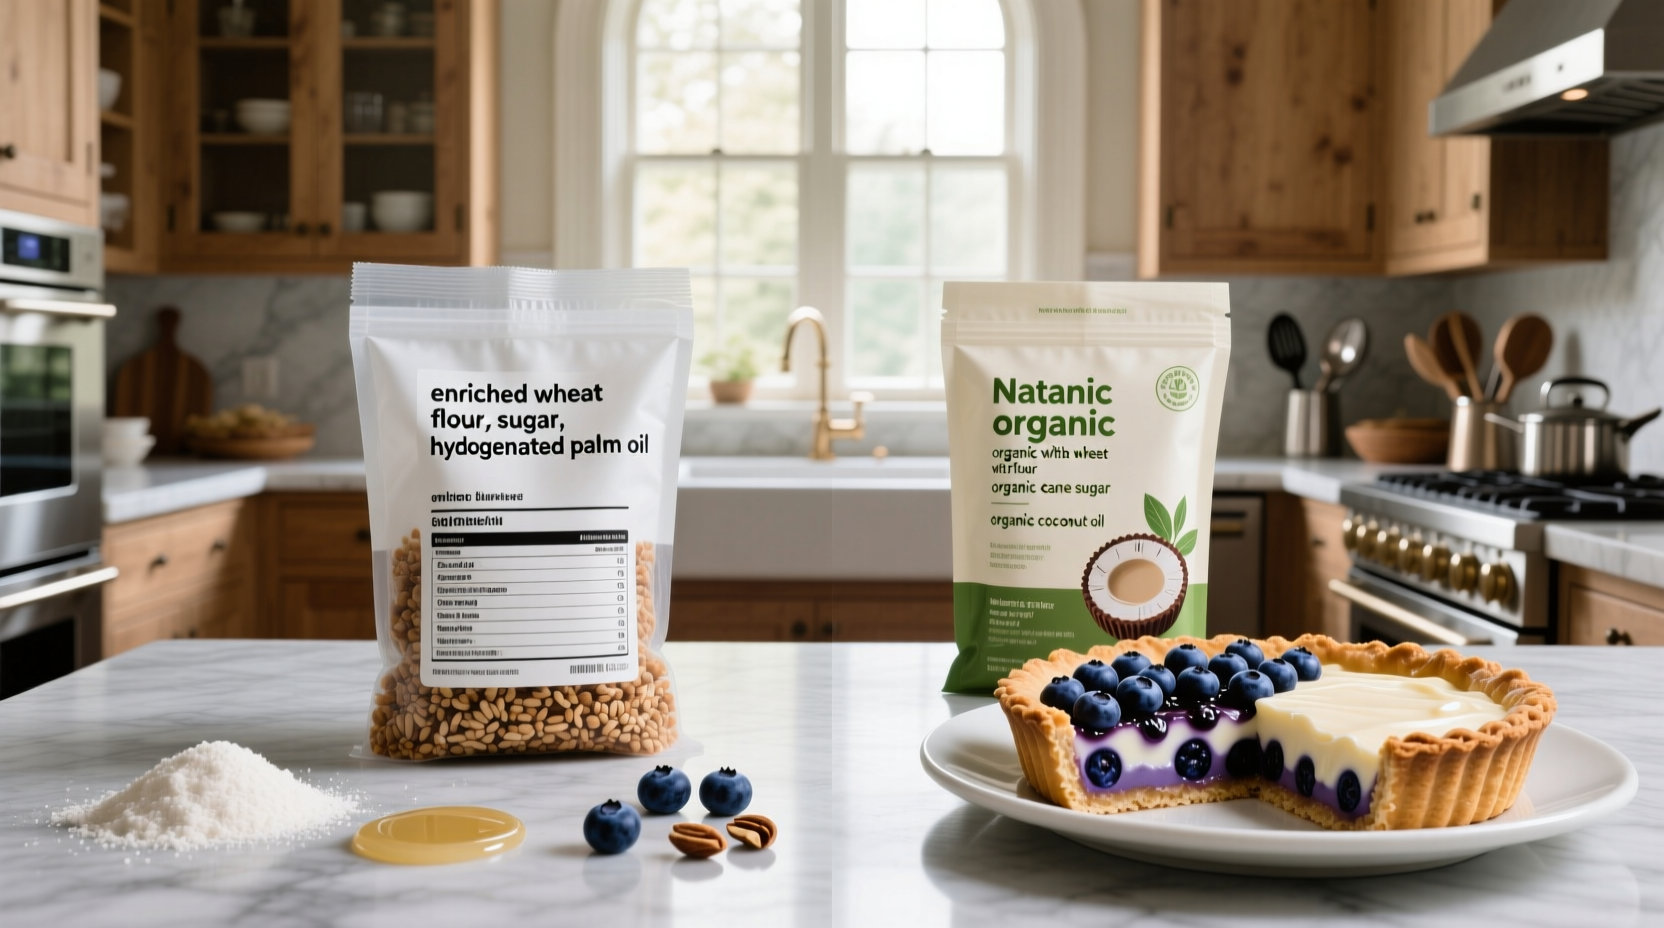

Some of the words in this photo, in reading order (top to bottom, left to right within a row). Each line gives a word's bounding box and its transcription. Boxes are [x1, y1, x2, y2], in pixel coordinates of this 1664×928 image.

[430, 382, 528, 404] enriched
[534, 383, 603, 403] wheat
[993, 377, 1113, 405] Natanic
[430, 408, 492, 432] flour,
[497, 413, 565, 434] sugar,
[993, 408, 1116, 443] organic
[430, 435, 564, 460] hydogenated
[570, 434, 621, 459] palm
[627, 434, 649, 454] oil
[992, 446, 1037, 461] organic
[991, 480, 1036, 496] organic
[1041, 482, 1072, 494] cane
[1075, 483, 1111, 497] sugar
[990, 513, 1034, 529] organic
[1038, 515, 1088, 527] coconut
[1091, 514, 1104, 527] oil
